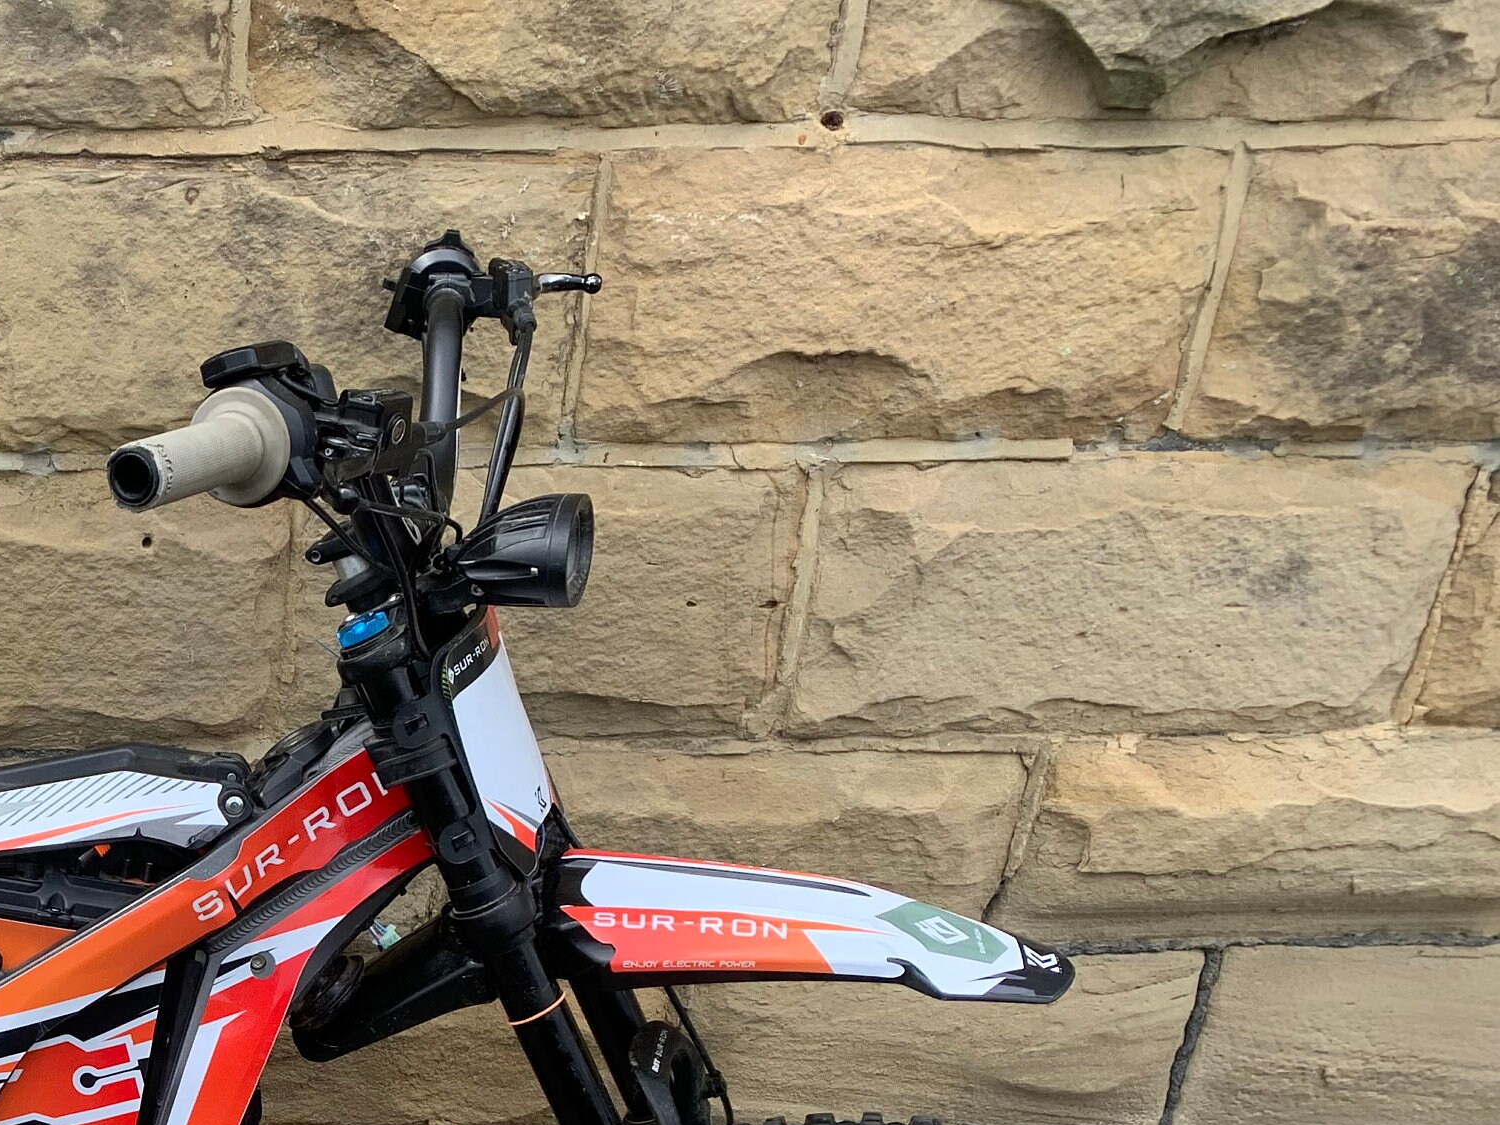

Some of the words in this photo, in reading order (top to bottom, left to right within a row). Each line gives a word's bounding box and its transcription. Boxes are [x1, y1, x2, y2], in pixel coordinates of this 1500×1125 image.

[593, 912, 788, 940] SUR-RON
[622, 960, 659, 968] ENJOY
[662, 960, 715, 968] ELECTRIC
[719, 960, 756, 968] POWER
